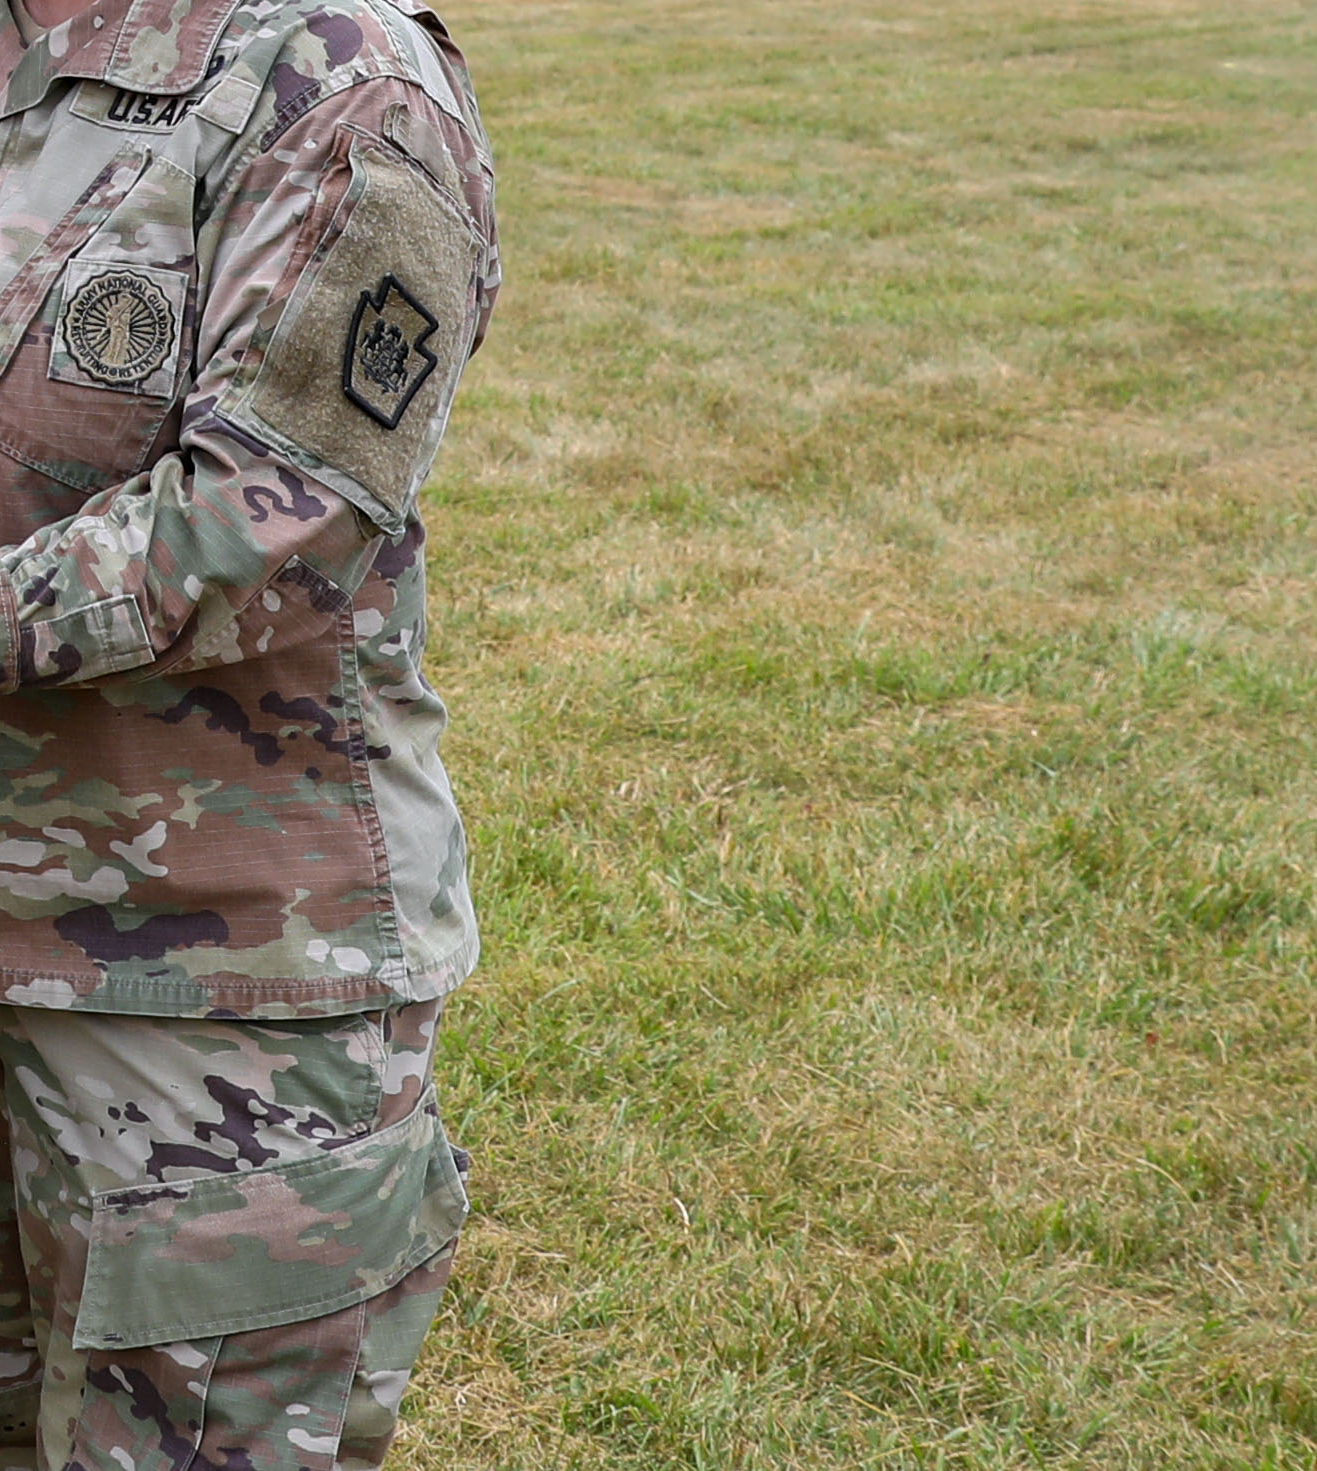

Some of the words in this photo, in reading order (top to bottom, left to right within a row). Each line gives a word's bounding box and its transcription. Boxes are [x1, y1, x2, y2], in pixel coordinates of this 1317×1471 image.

[75, 285, 100, 316] ARMY
[98, 277, 147, 297] NATIONAL
[147, 294, 168, 330] GUARD
